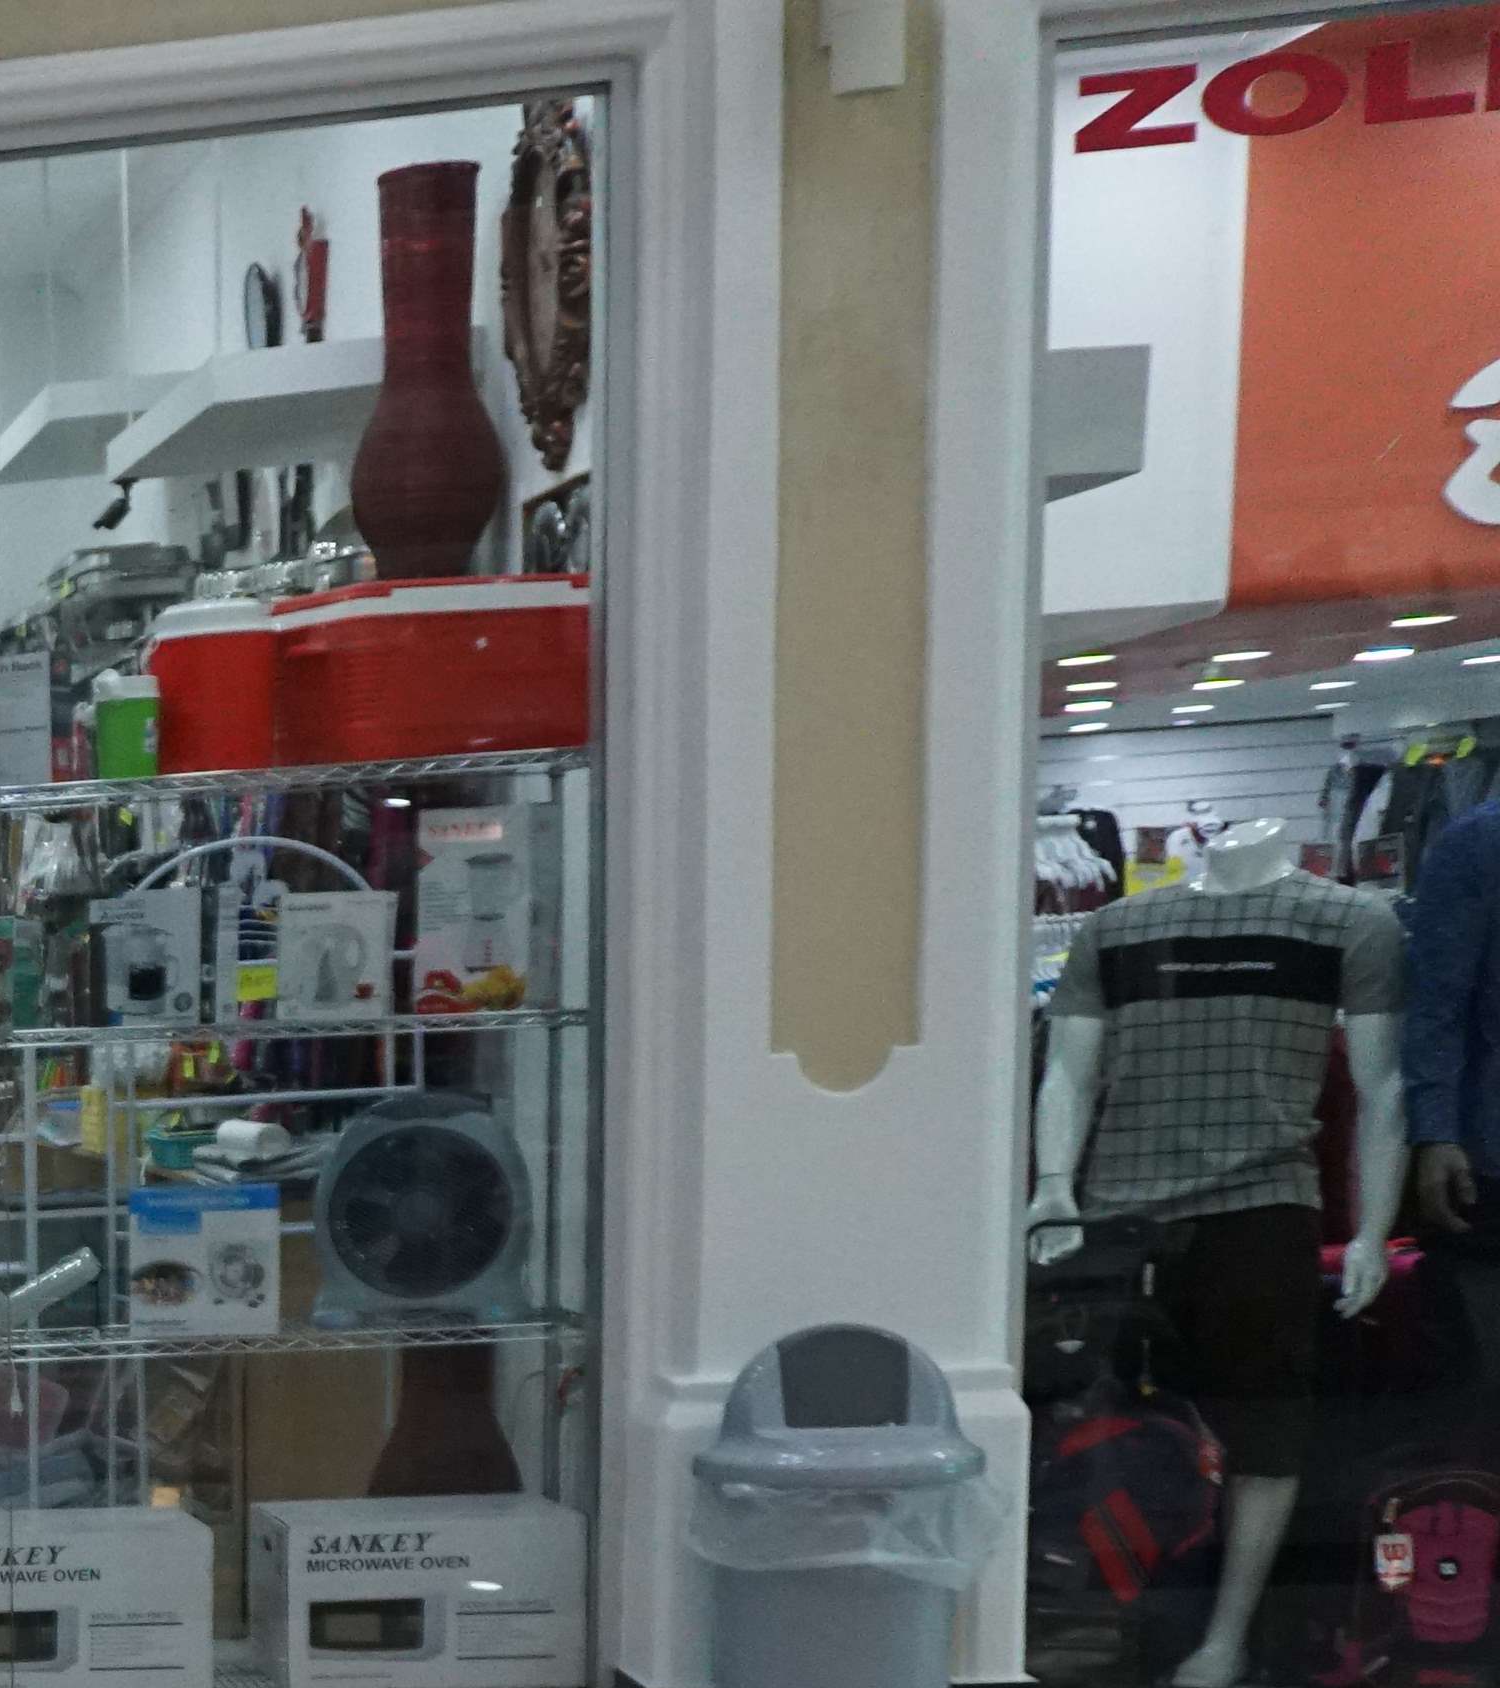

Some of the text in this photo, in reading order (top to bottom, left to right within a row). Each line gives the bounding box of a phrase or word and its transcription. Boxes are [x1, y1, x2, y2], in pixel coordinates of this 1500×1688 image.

[1073, 30, 1500, 155] ZOL
[306, 1531, 435, 1555] SANKEY
[52, 1566, 102, 1583] OVEN
[305, 1555, 472, 1574] MICROWAVE OVEN
